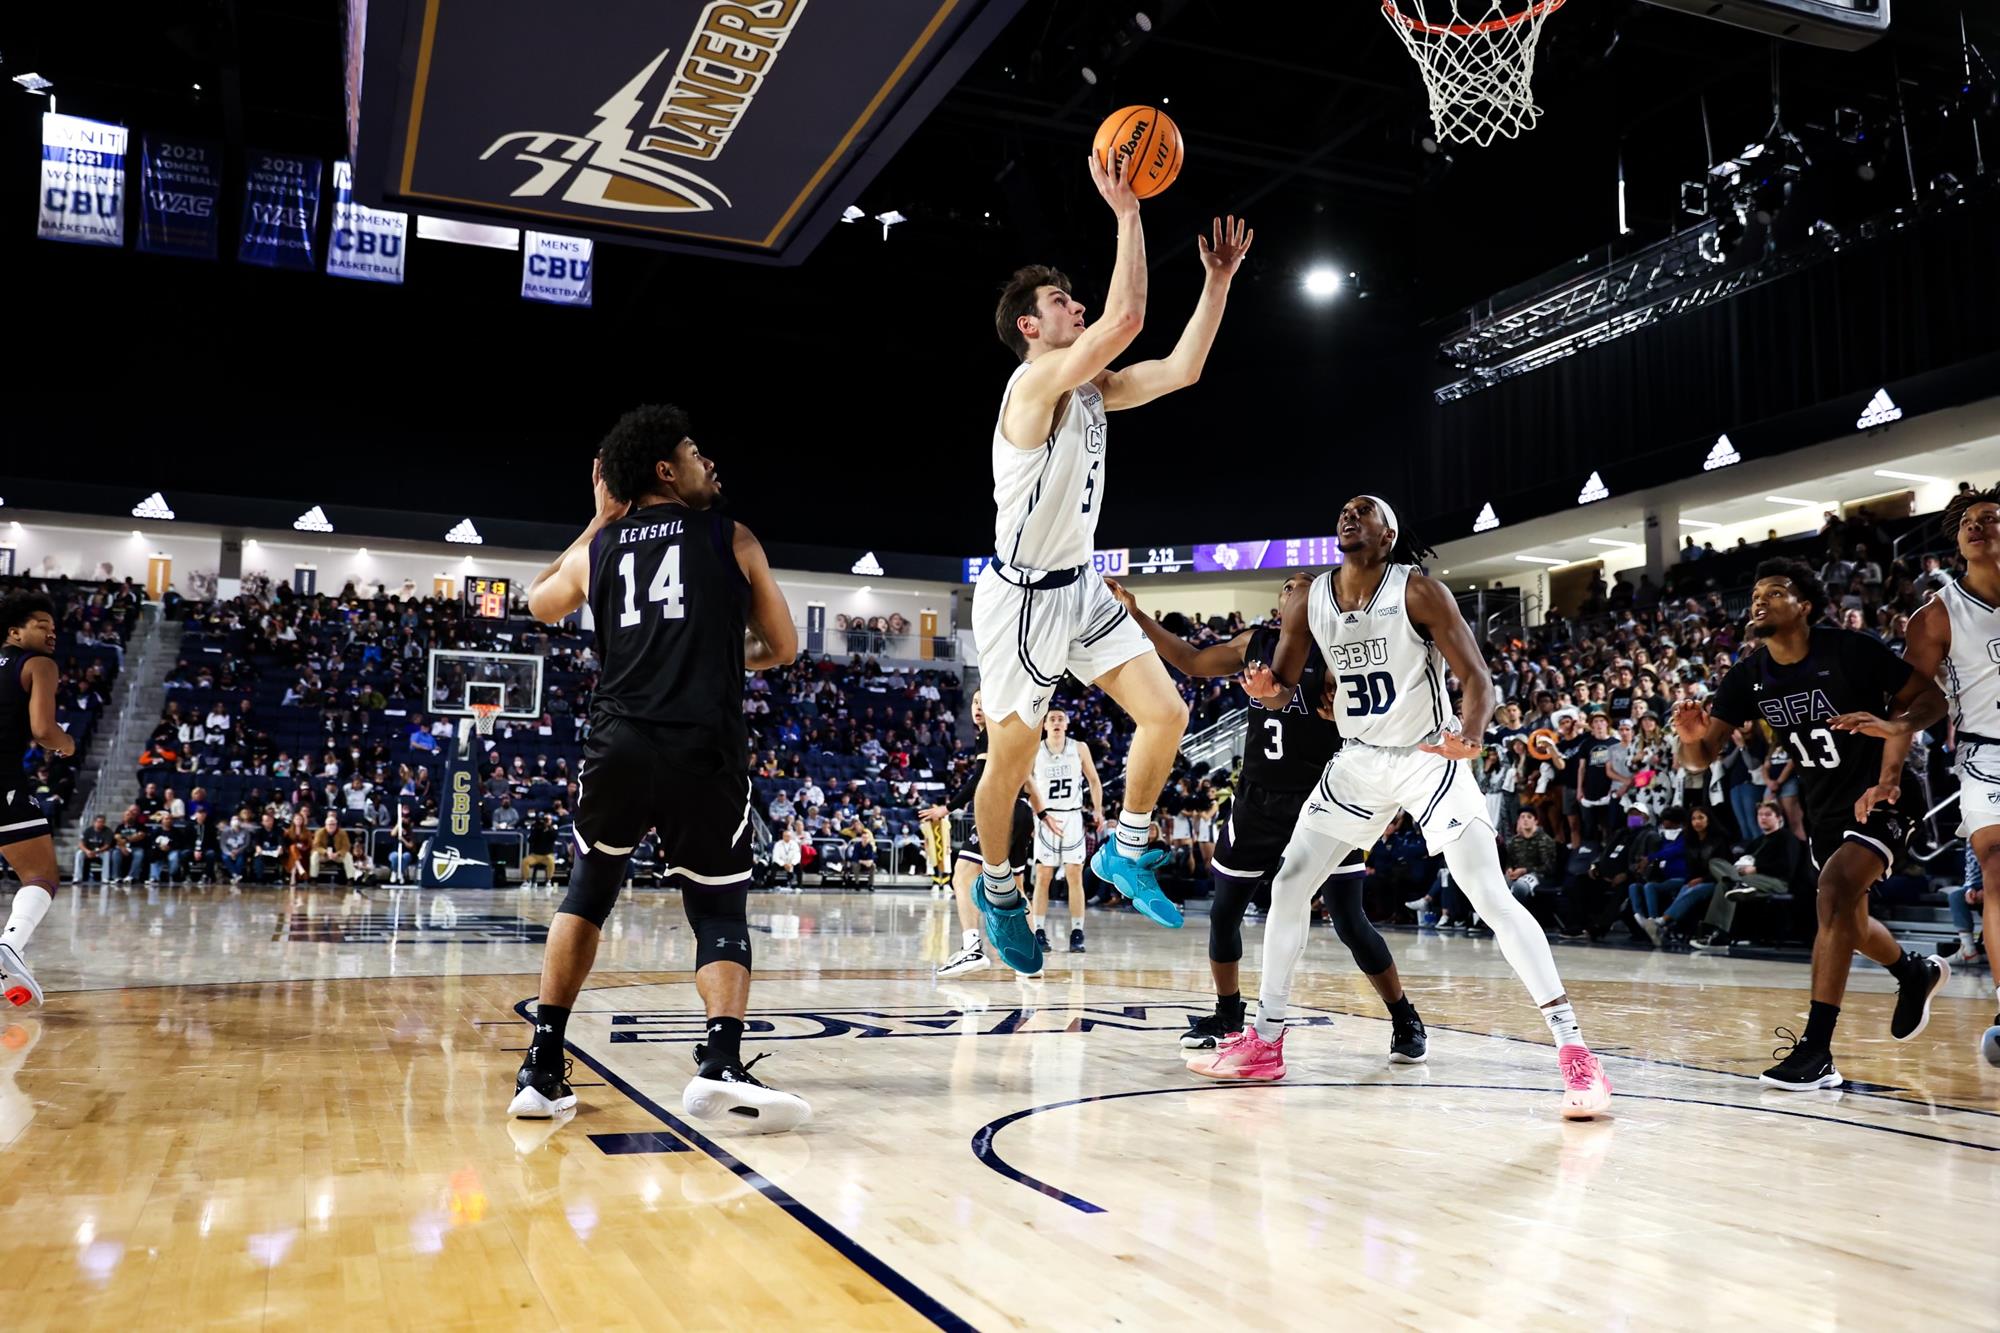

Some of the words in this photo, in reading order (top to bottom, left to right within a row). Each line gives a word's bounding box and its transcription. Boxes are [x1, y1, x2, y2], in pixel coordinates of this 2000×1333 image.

[66, 149, 103, 166] 2021
[161, 143, 206, 162] 2021
[262, 156, 305, 176] 2021
[46, 169, 122, 188] WOMEN'S
[45, 187, 119, 219] CBU
[150, 189, 215, 218] WAC
[252, 202, 310, 231] WAC
[337, 210, 403, 229] WOMEN'S
[41, 220, 121, 239] BASKETBALL
[336, 227, 401, 258] CBU
[541, 239, 580, 253] MEN'S
[330, 258, 402, 276] BASKETBALL
[528, 253, 590, 281] CBU
[524, 283, 588, 299] BASKETBALL
[1856, 408, 1902, 429] adidas
[1703, 452, 1741, 470] adidas
[619, 519, 685, 544] KENSMIL
[1093, 553, 1123, 573] BU
[618, 545, 685, 628] 14
[1329, 637, 1388, 670] CBU
[1340, 671, 1397, 716] 30
[1758, 689, 1840, 727] SFA
[1264, 718, 1284, 760] 3
[1789, 728, 1841, 768] 13
[1045, 765, 1072, 778] CBU
[1048, 778, 1073, 799] 25
[451, 771, 471, 835] CBU
